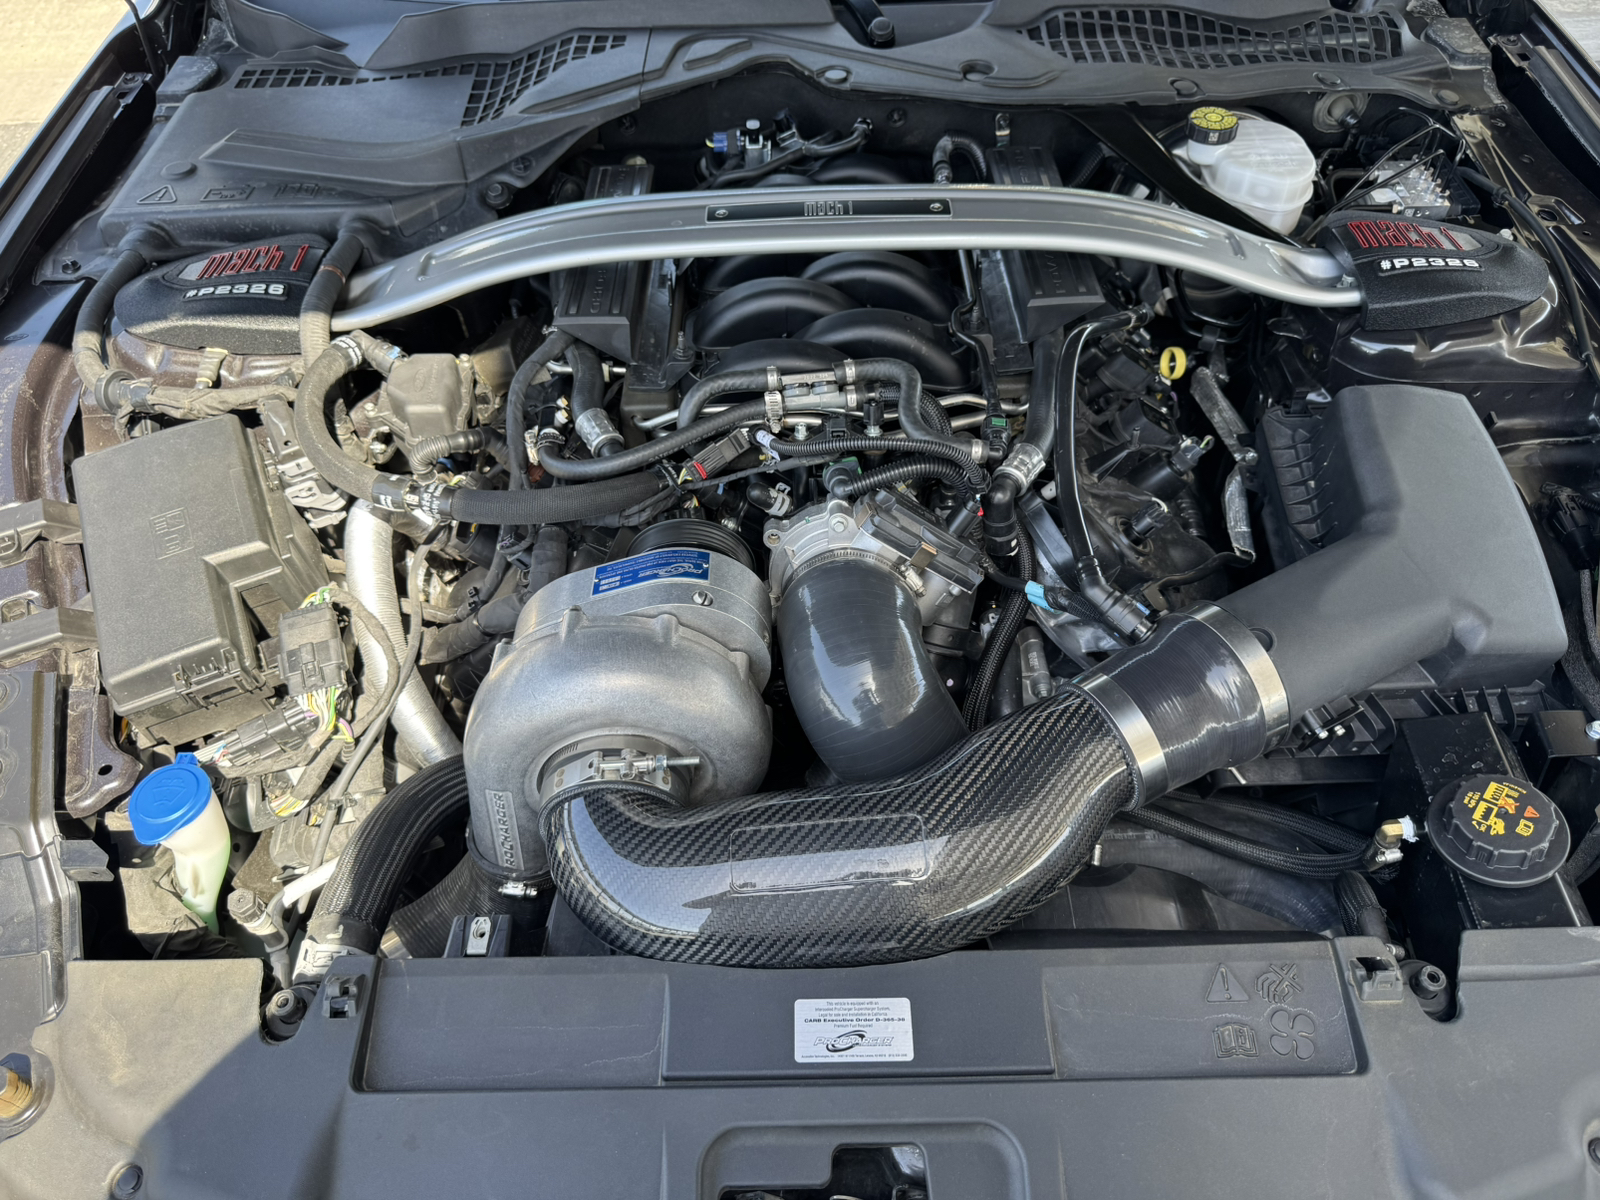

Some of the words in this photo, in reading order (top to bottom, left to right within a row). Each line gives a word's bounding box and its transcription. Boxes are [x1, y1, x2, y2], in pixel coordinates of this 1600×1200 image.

[847, 200, 854, 215] 1
[1440, 226, 1465, 251] 1
[290, 244, 310, 272] 1
[1380, 258, 1479, 270] #P2326
[185, 284, 285, 298] #P2326
[494, 793, 516, 867] ROCHARGER
